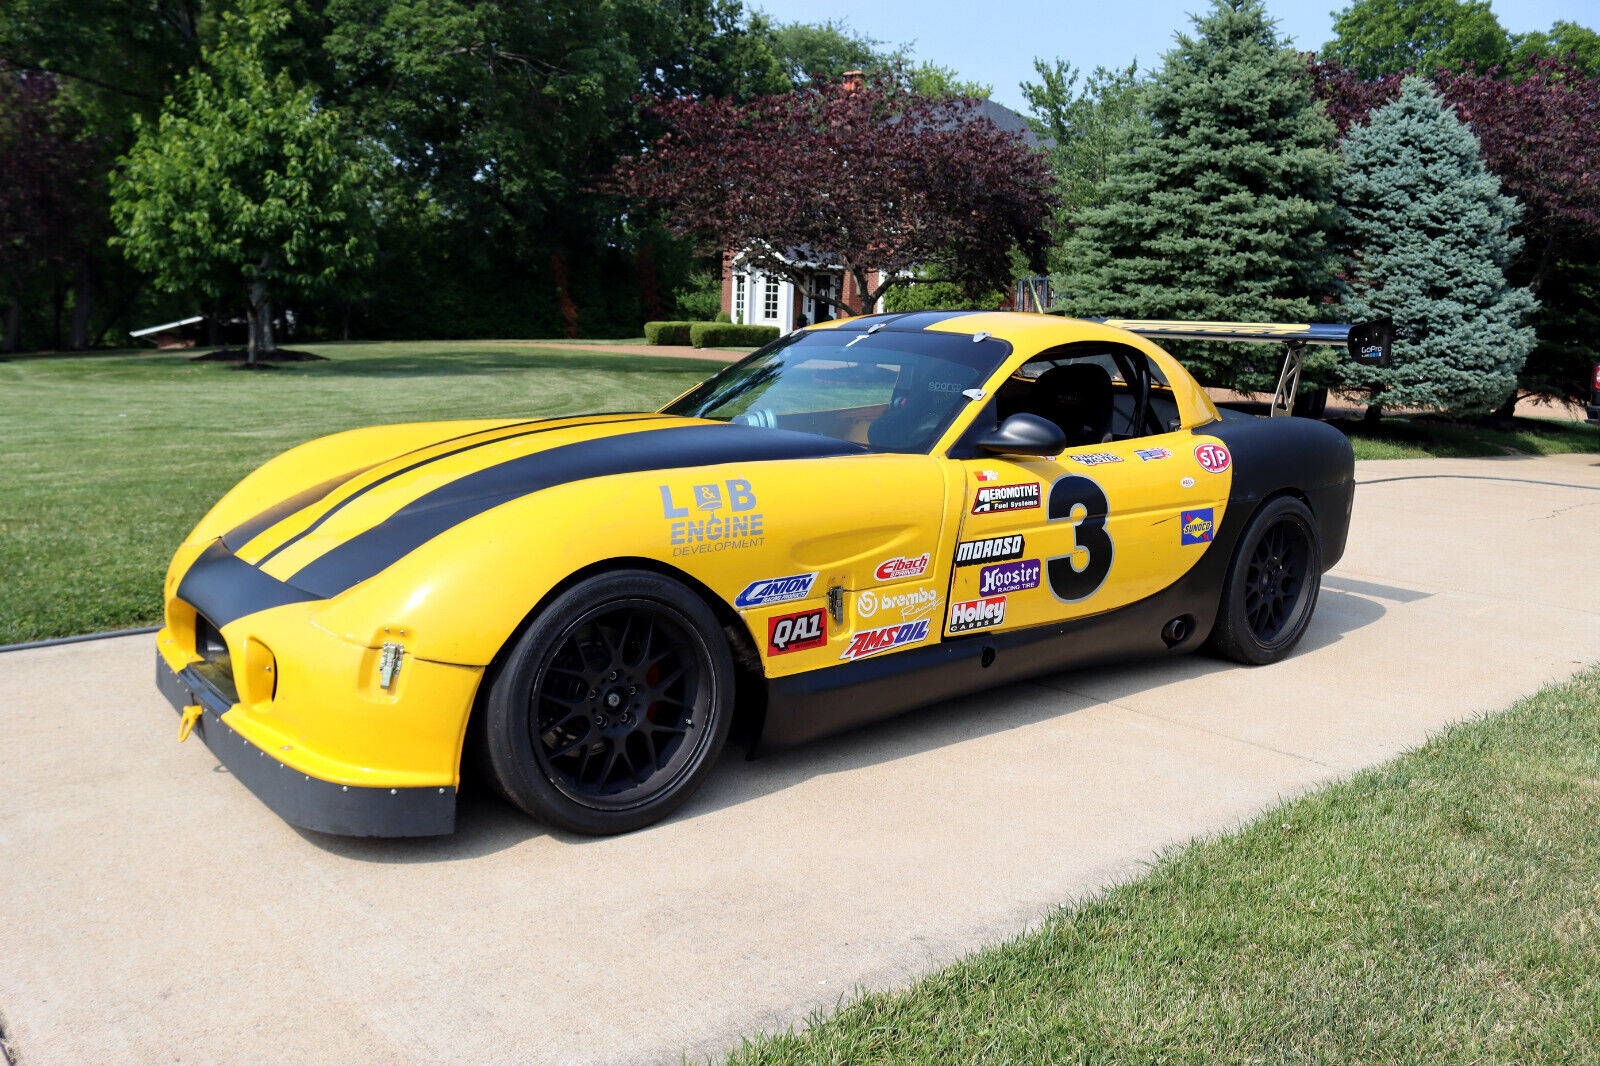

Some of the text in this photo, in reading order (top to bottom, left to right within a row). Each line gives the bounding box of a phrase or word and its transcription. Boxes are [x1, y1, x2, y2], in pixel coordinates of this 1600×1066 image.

[1361, 345, 1382, 354] GoPro
[1200, 446, 1227, 467] STP
[658, 479, 757, 519] L & B
[974, 485, 1039, 513] AEROMOTIVE
[994, 500, 1038, 510] Fuel Systems
[671, 514, 764, 545] ENGINE
[1046, 473, 1115, 604] 3
[1184, 521, 1211, 534] SUNOCO
[672, 537, 766, 557] DEVELOPMENT
[956, 536, 1022, 562] MOROSO
[876, 555, 928, 580] Eibach
[981, 562, 1040, 592] Hoosier
[735, 573, 814, 607] CANTON
[881, 586, 938, 610] brembo
[997, 584, 1021, 593] RACING
[951, 600, 1005, 625] Holley
[773, 614, 822, 649] QA1
[950, 619, 991, 632] CARBS
[844, 620, 929, 658] AMSOIL
